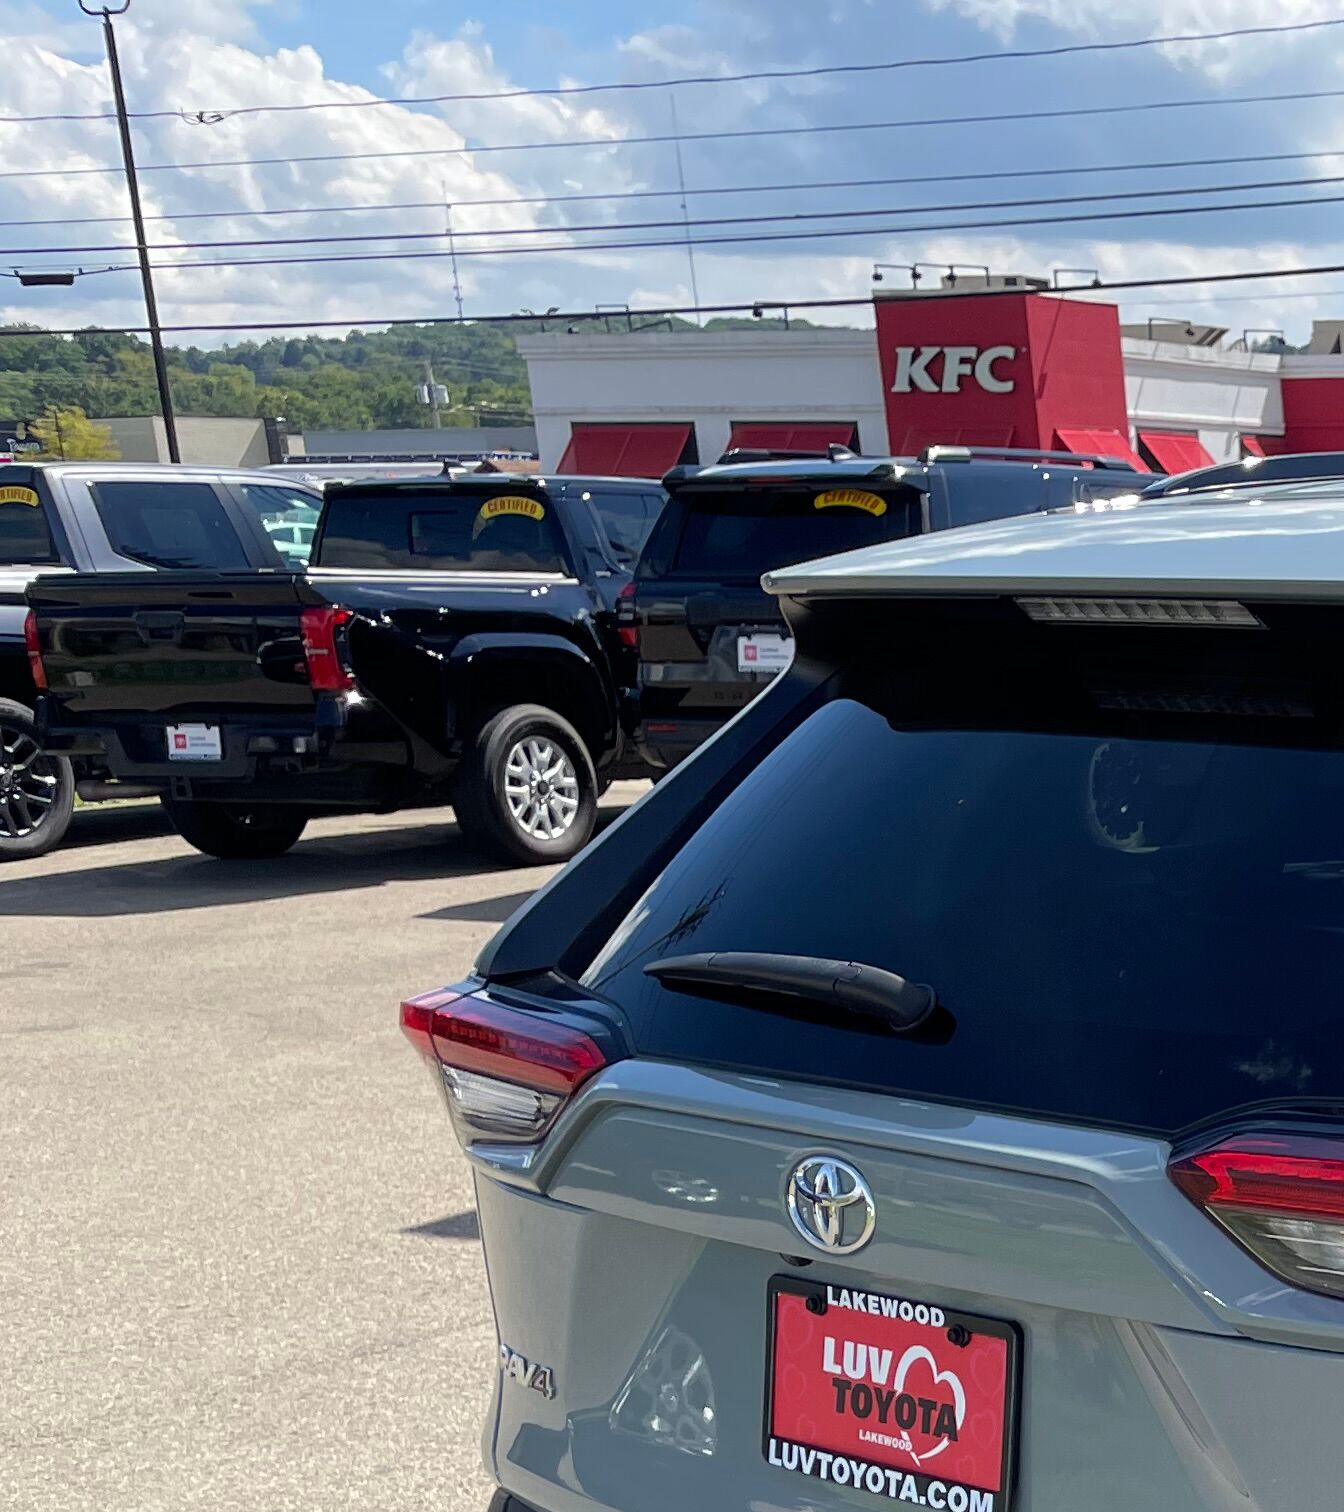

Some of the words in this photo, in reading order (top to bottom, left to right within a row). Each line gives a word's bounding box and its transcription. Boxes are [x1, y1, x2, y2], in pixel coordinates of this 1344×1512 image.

[891, 345, 1015, 393] KFC
[487, 499, 537, 514] CERTIFIED
[824, 491, 880, 510] CERTIFIED
[826, 1286, 945, 1328] LAKEWOOD
[500, 1344, 556, 1400] RAV4
[822, 1336, 893, 1386] LUV
[832, 1377, 958, 1441] TOYOTA
[858, 1429, 913, 1452] LAKEWOOD
